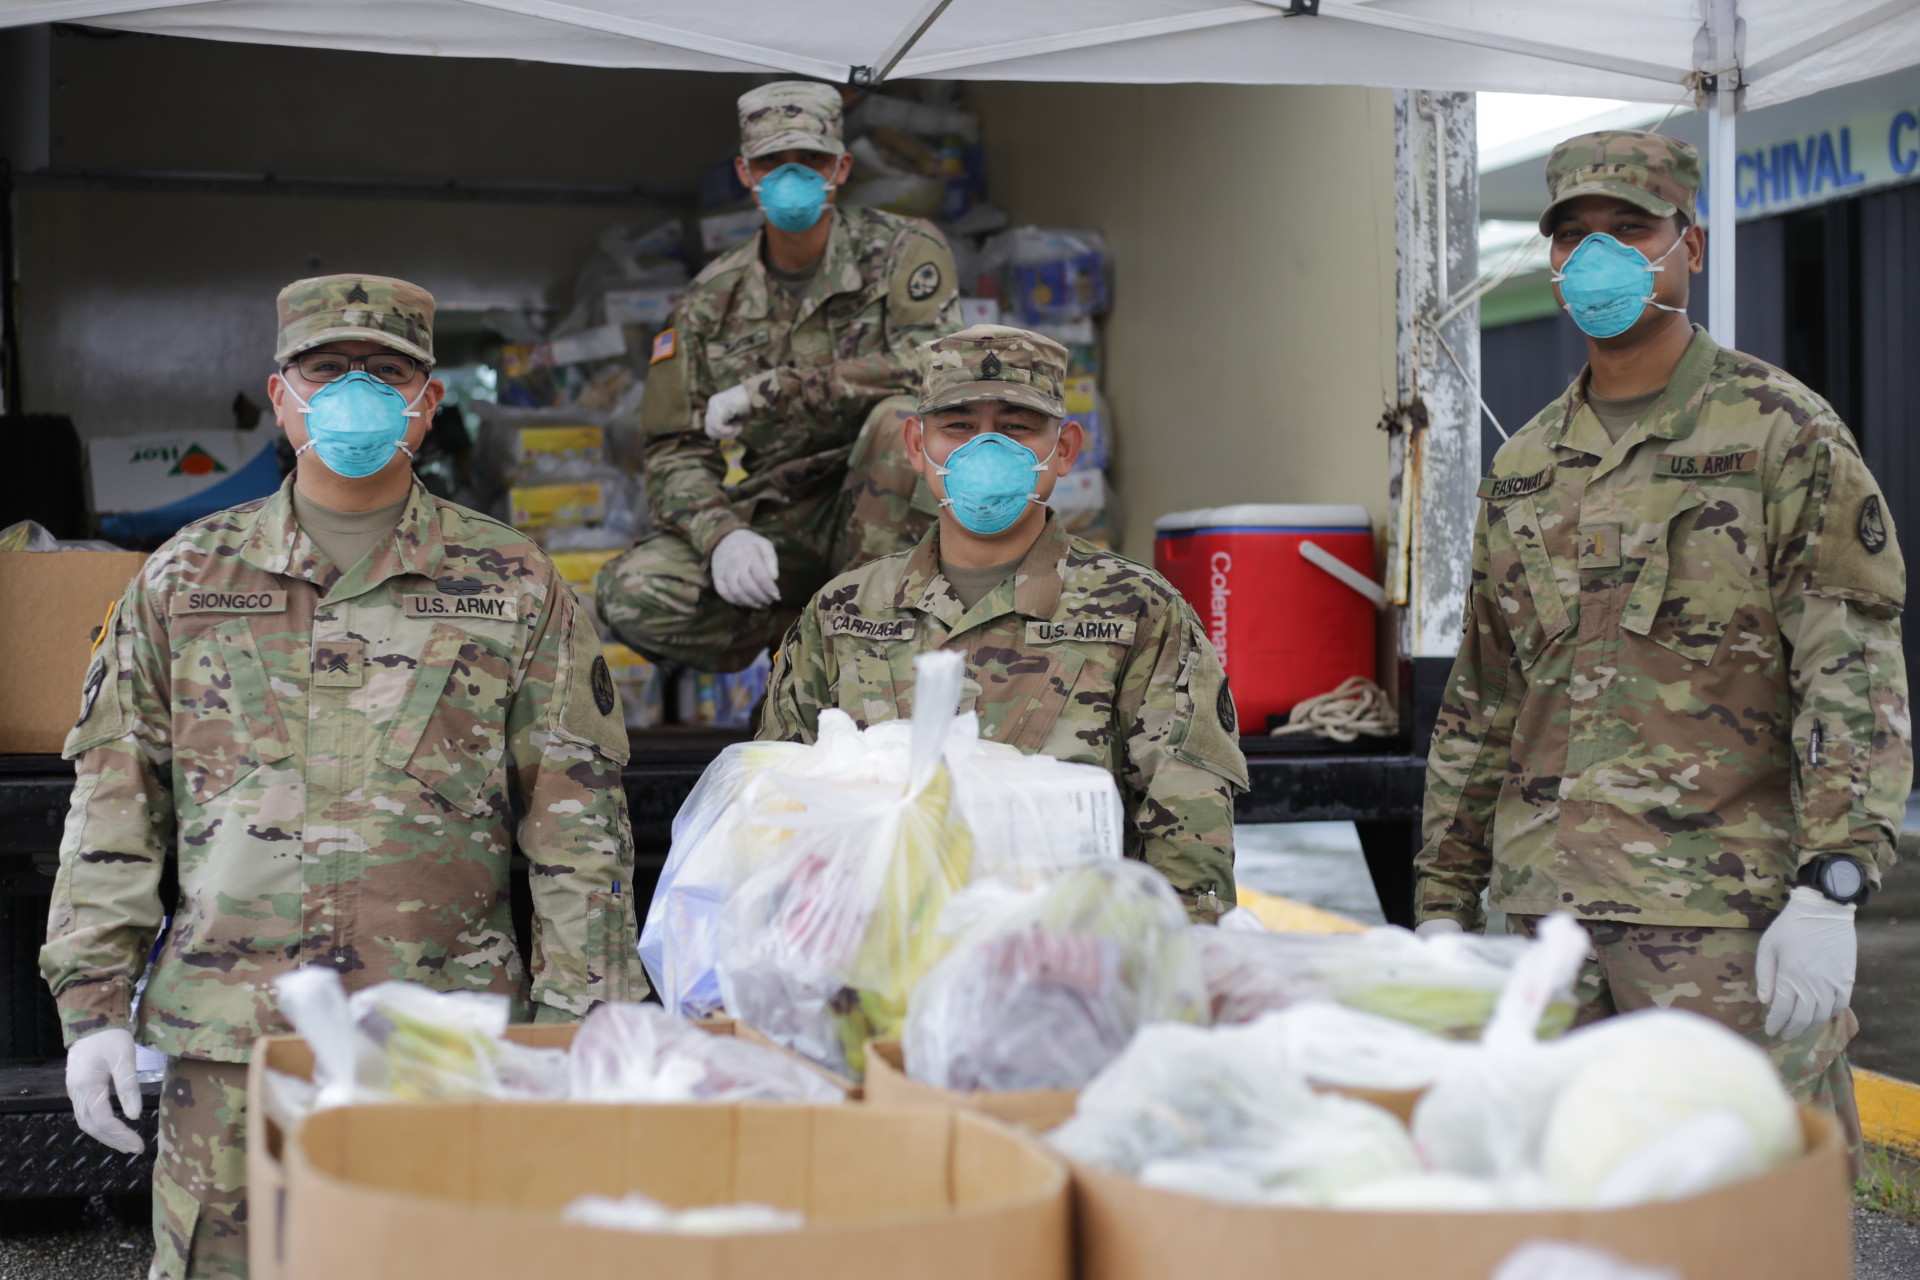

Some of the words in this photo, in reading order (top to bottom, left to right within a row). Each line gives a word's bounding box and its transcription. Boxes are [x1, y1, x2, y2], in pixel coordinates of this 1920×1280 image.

[1697, 127, 1864, 216] CHIVAL
[1889, 111, 1920, 174] C
[1671, 456, 1698, 474] U.S.
[1703, 452, 1745, 474] ARMY
[189, 593, 273, 609] SIONGCO
[415, 597, 449, 613] U.S.
[455, 598, 505, 616] ARMY
[832, 615, 903, 636] CARRIAGA
[1039, 624, 1068, 640] U.S.
[1073, 622, 1124, 639] ARMY
